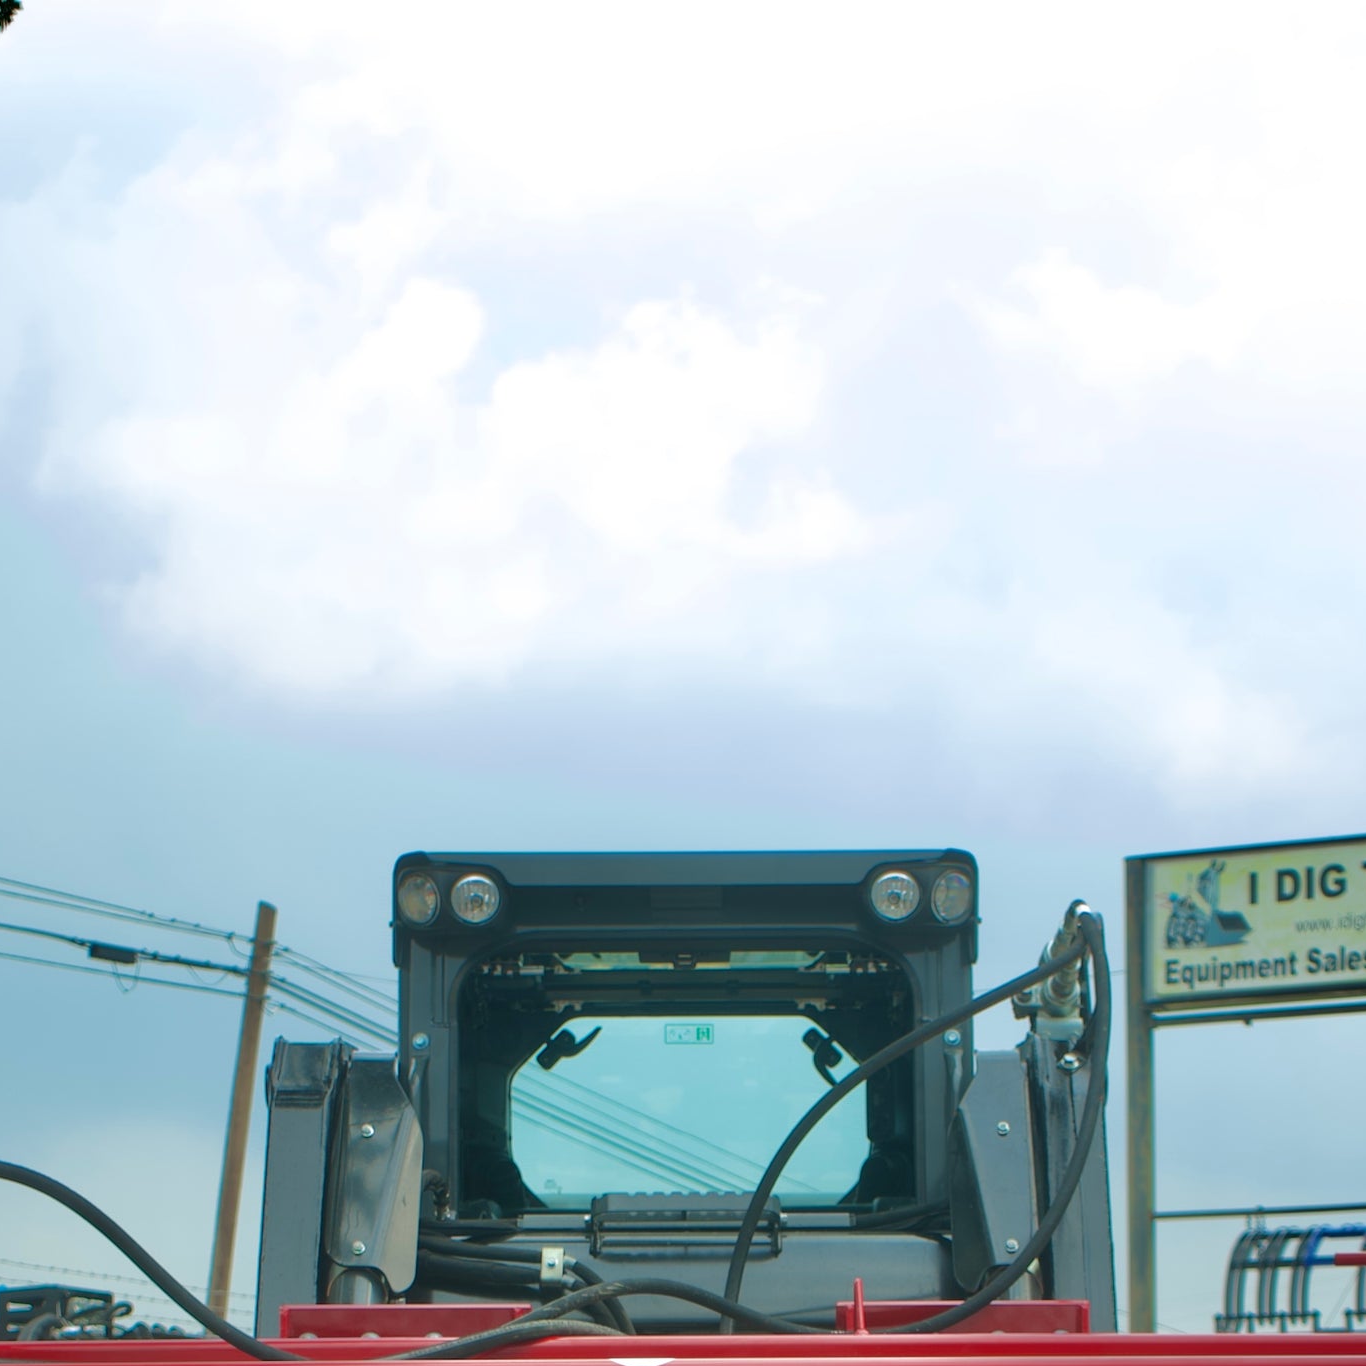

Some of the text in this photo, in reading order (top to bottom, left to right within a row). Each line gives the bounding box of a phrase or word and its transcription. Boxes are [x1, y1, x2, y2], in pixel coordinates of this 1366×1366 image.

[1248, 871, 1259, 904] I
[1276, 864, 1346, 902] DIG
[1165, 951, 1296, 988] Equipment
